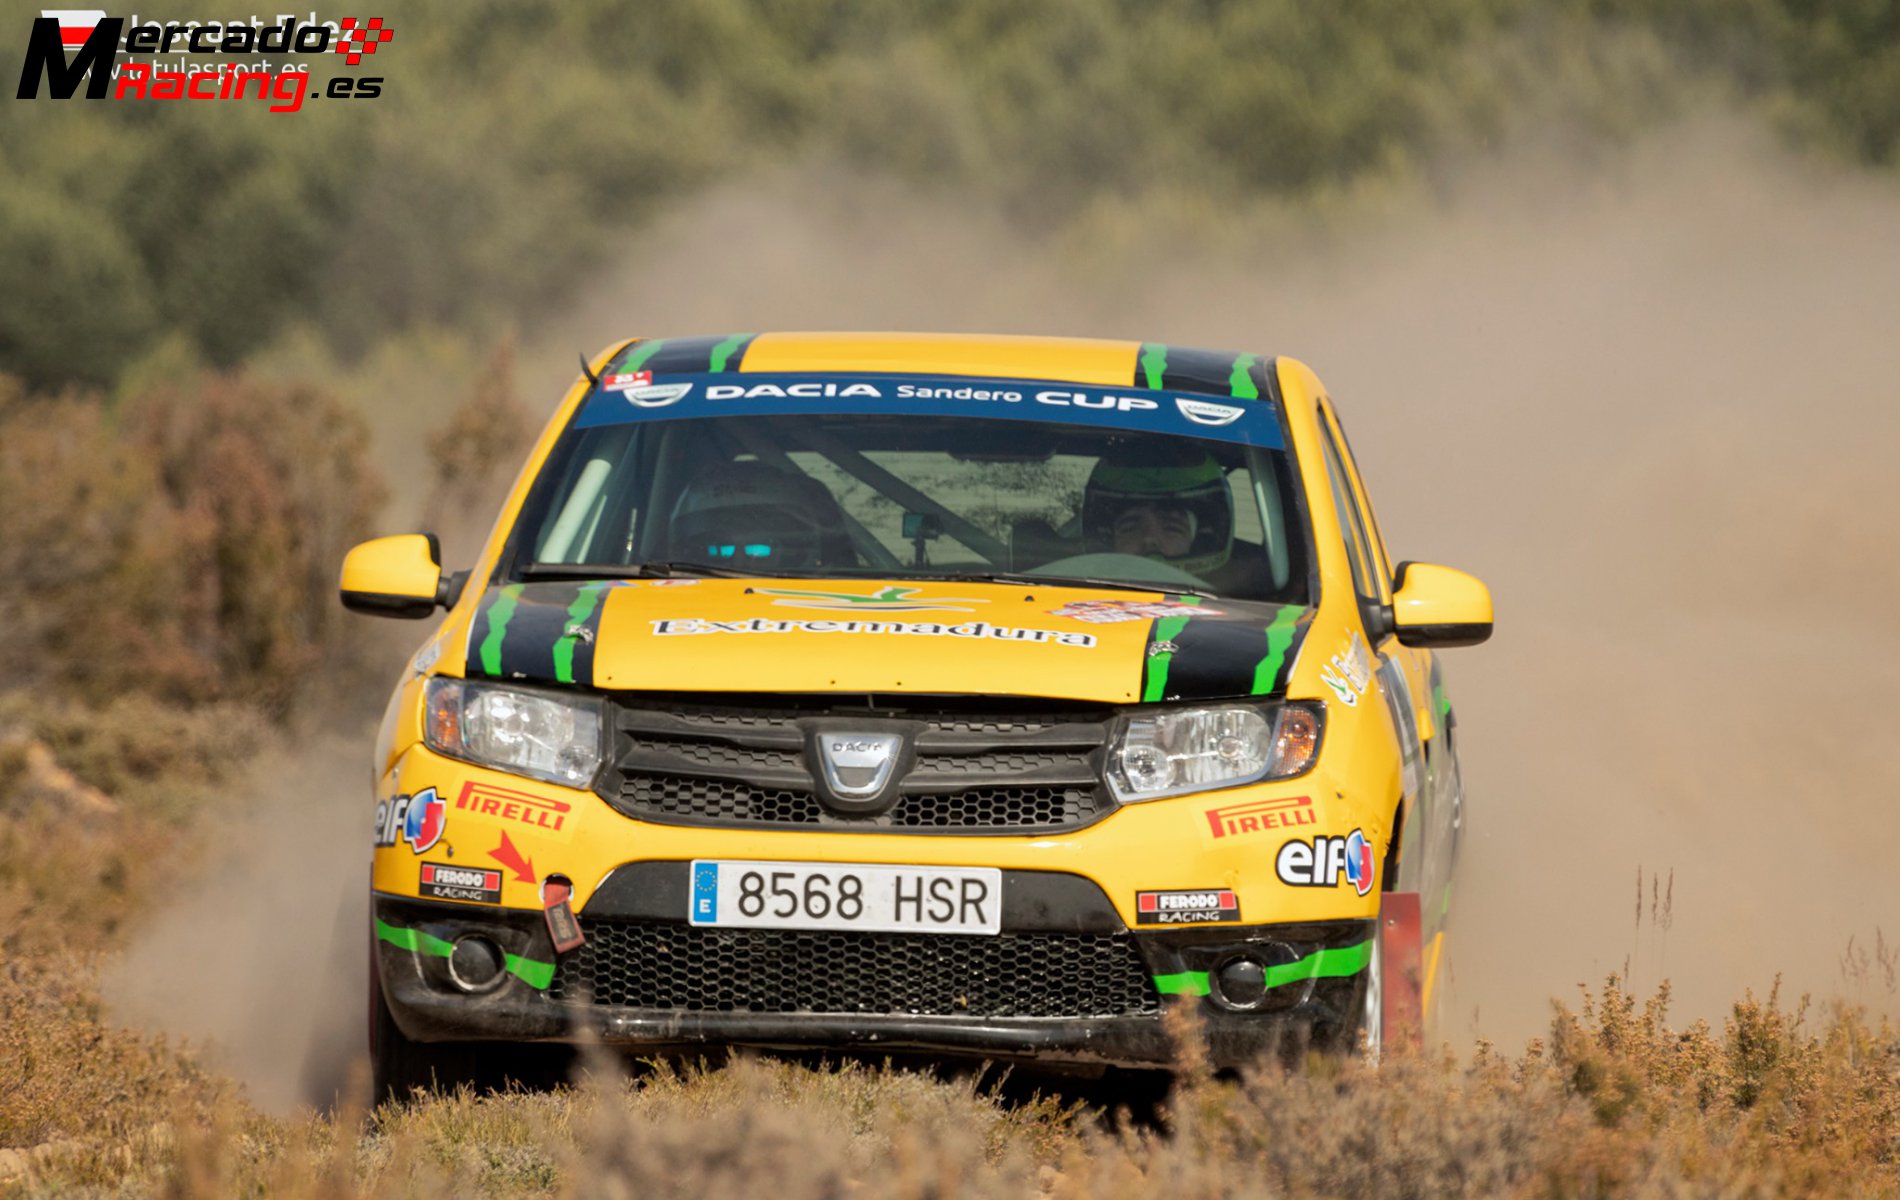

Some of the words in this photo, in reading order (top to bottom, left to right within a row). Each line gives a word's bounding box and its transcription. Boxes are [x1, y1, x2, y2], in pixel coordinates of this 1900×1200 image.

[706, 383, 882, 400] DACIA
[897, 385, 1022, 402] Sandero
[1035, 391, 1159, 411] CUP
[650, 618, 1097, 649] Extremadura
[455, 780, 572, 831] PIRELLI
[1205, 795, 1316, 839] PIRELLI
[375, 797, 410, 846] elf
[1277, 838, 1345, 885] elf
[434, 869, 484, 886] FERODO
[433, 887, 482, 901] RACING
[699, 899, 711, 913] E
[738, 871, 863, 919] 8568
[894, 875, 988, 924] HSR
[1159, 894, 1218, 909] FERODO
[1158, 911, 1220, 922] RACING
